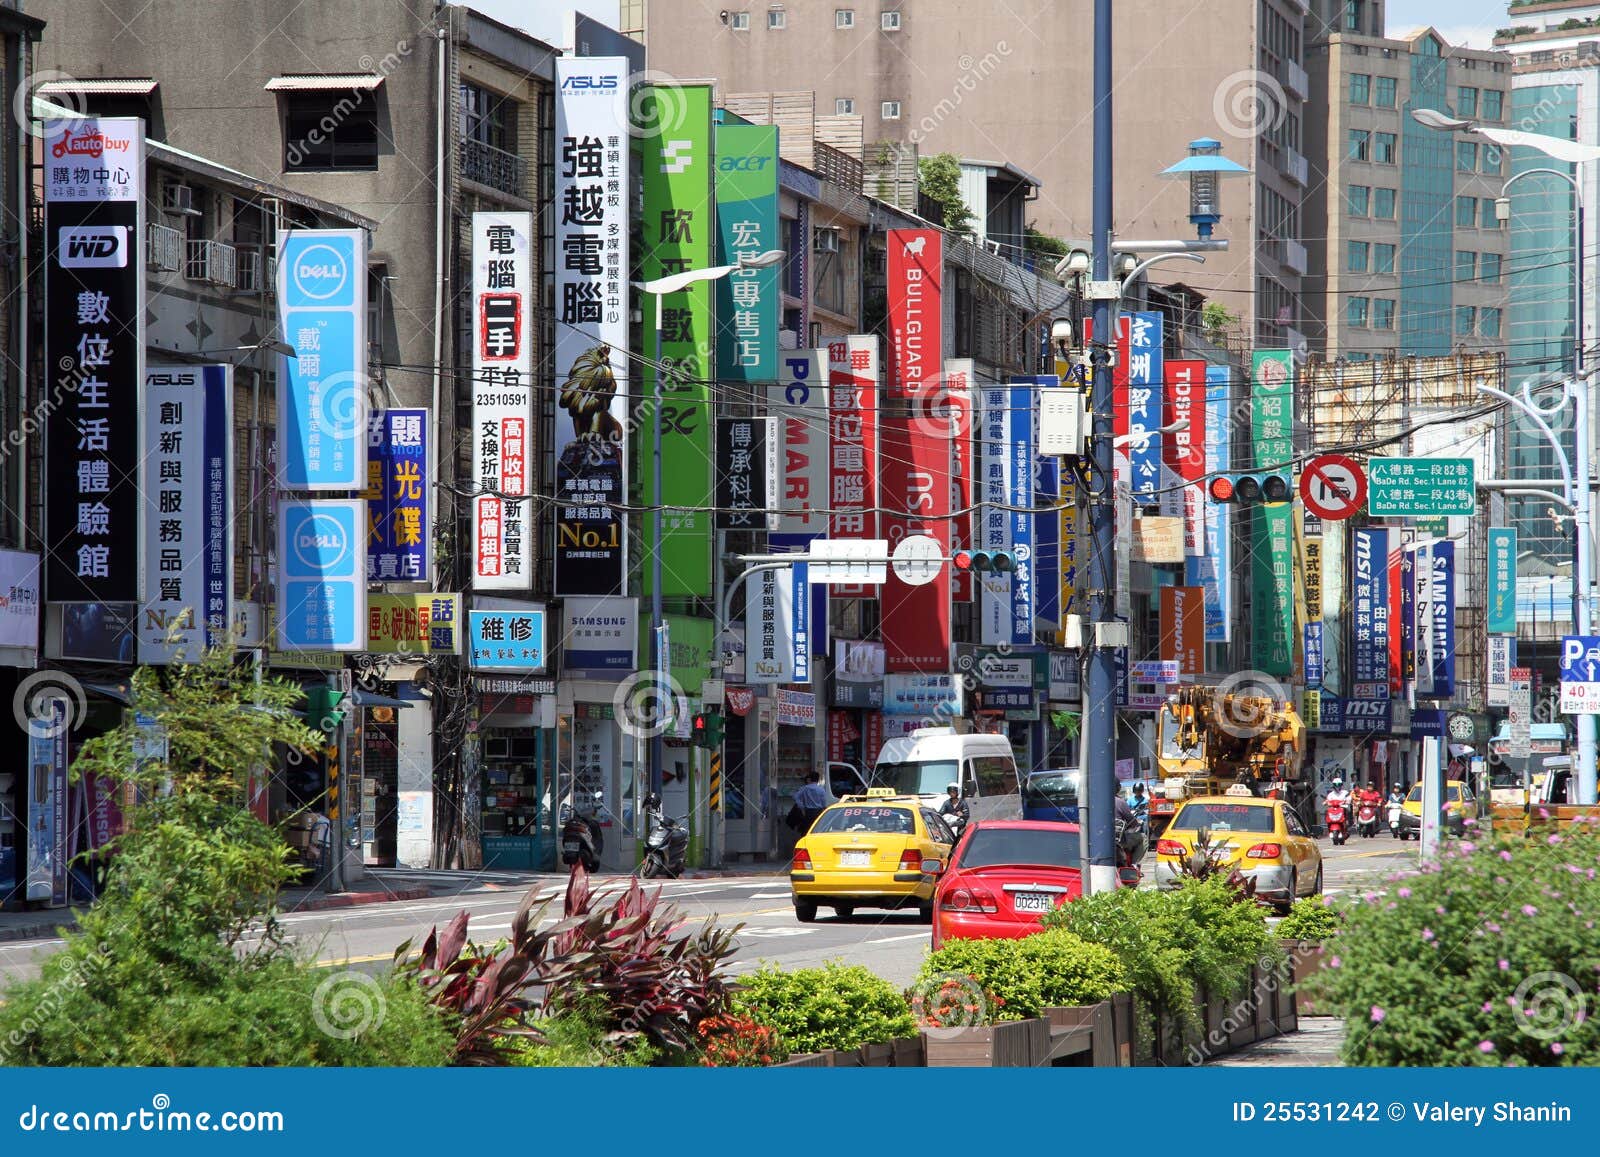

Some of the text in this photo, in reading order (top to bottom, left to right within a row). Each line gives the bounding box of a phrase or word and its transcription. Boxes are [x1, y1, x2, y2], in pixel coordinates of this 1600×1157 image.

[562, 76, 617, 88] ASUS
[73, 137, 130, 152] auto buy
[719, 155, 771, 171] acer
[53, 167, 130, 184] 購物中心
[68, 235, 119, 258] WD
[562, 136, 604, 324] 強越電腦
[300, 266, 341, 279] DELL
[486, 225, 515, 289] 電腦
[298, 328, 320, 377] 戴爾
[486, 300, 515, 356] 二手
[906, 268, 922, 393] BULLGUARD
[146, 374, 195, 386] ASUS
[476, 394, 527, 406] 23510591
[481, 367, 521, 387] 平台
[785, 358, 809, 405] PC
[77, 291, 110, 578] 數位生活體驗館
[481, 420, 498, 491] 交換折讓
[504, 420, 523, 495] 高價收購
[565, 479, 613, 491] 華碩電腦
[729, 423, 752, 525] 傳承科技
[786, 418, 809, 524] MART
[833, 383, 864, 593] 數位電腦用
[1376, 464, 1468, 475] 八德路一段82巷
[159, 401, 182, 601] 創新與服務品質
[393, 460, 421, 547] 光碟
[565, 507, 612, 519] 服務品質
[300, 535, 341, 547] DELL
[481, 501, 499, 575] 設備租賃
[504, 501, 522, 575] 新舊買賣
[558, 523, 619, 547] No.1
[1357, 531, 1371, 580] msi
[431, 598, 453, 649] 話題
[481, 617, 532, 641] 維修
[572, 617, 626, 626] SAMSUNG
[763, 571, 775, 659] 創新與服務品質
[1174, 590, 1186, 648] lenovo
[1357, 584, 1371, 642] 微星科技
[1433, 557, 1447, 660] SAMSUNG
[756, 661, 784, 675] No.1
[1565, 640, 1584, 669] P
[1346, 701, 1387, 716] msi
[1569, 685, 1585, 697] 40
[95, 777, 109, 846] OSHIBA
